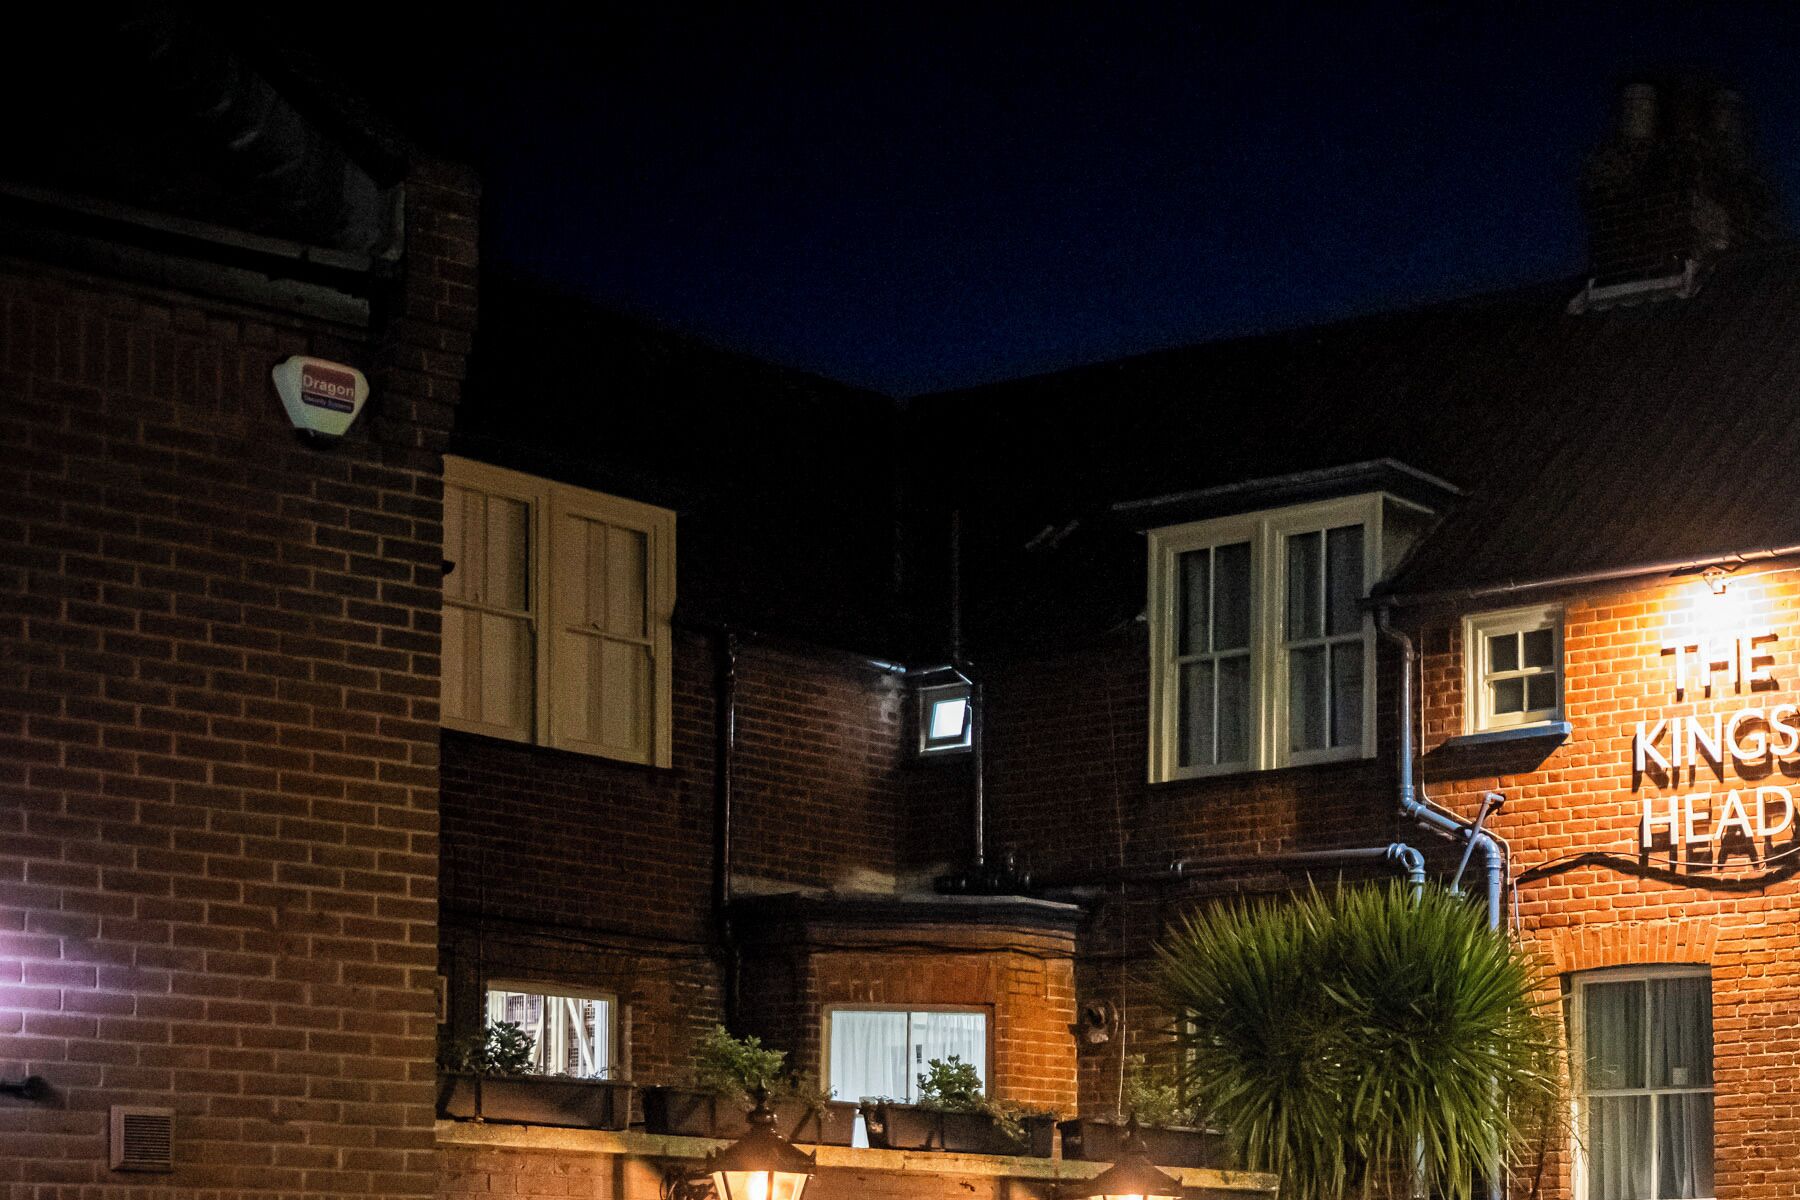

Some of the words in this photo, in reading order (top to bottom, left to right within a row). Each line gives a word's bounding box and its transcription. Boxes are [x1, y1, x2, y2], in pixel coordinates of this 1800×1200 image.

[303, 374, 354, 398] Dragon
[1661, 628, 1775, 690] THE
[1635, 703, 1799, 772] KINGS
[1642, 785, 1795, 848] HEAD
